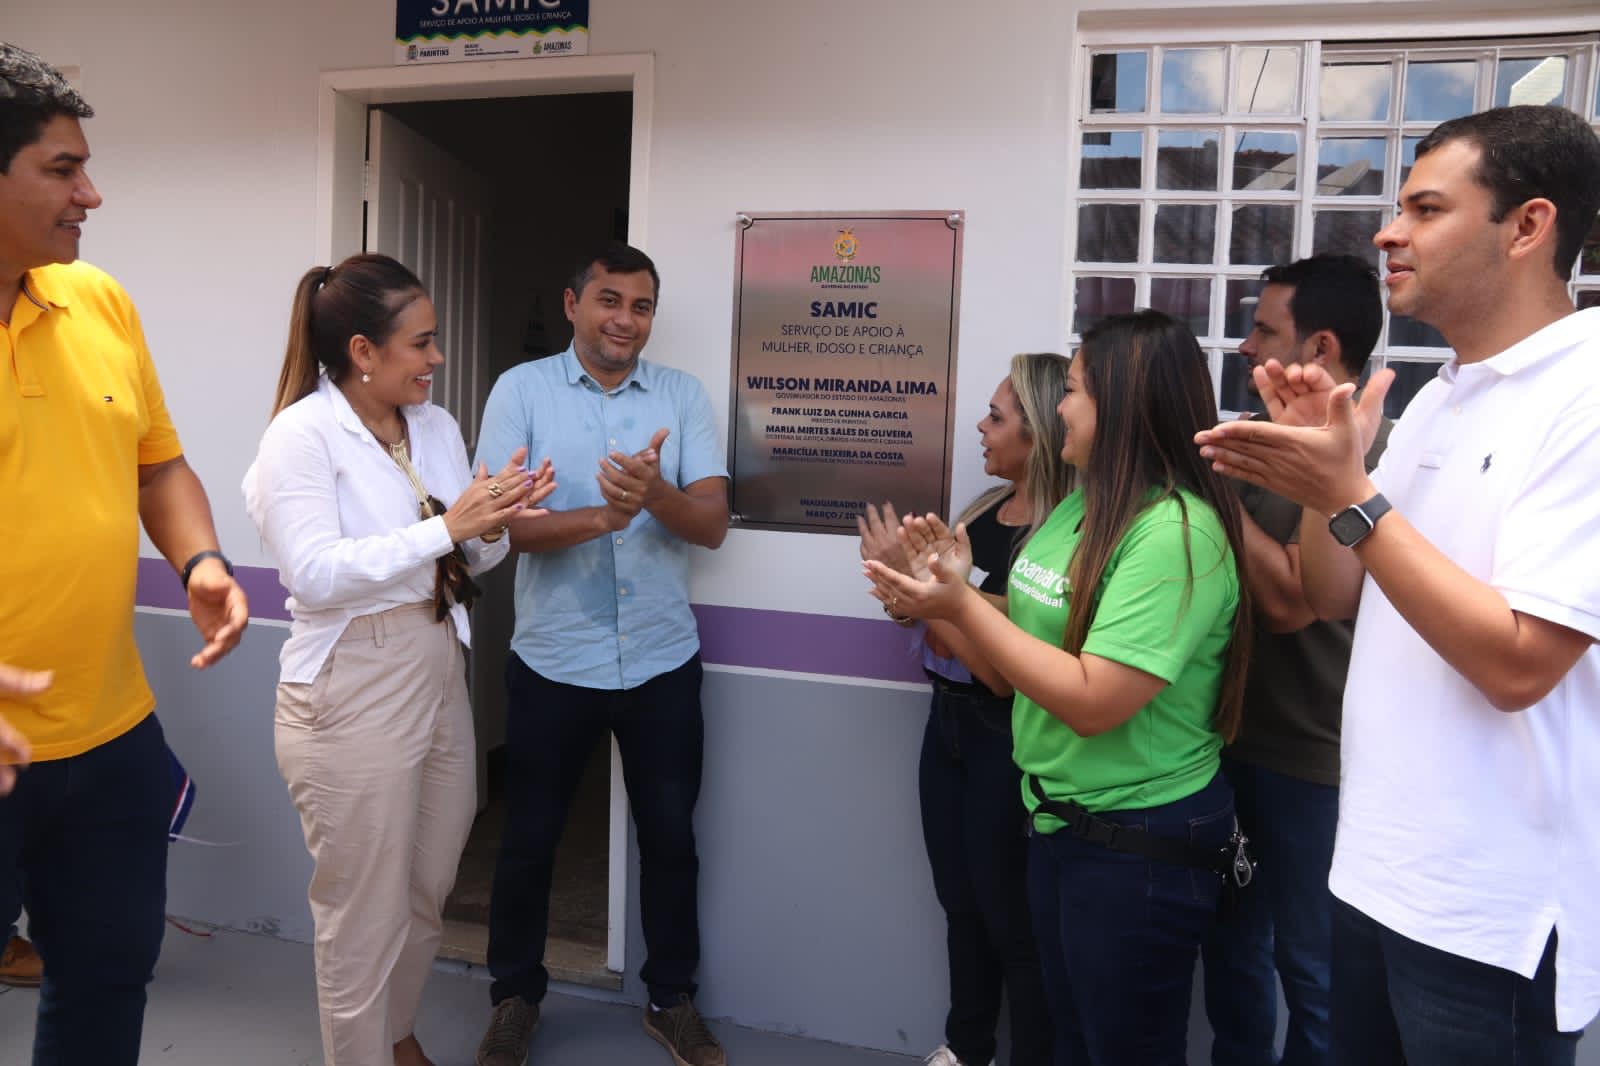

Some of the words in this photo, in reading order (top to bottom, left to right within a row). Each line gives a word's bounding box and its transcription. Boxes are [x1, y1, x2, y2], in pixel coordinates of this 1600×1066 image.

[544, 41, 572, 50] AMAZONAS
[420, 49, 449, 57] PARINTINS
[810, 265, 881, 283] AMAZONAS
[810, 301, 878, 318] SAMIC
[781, 324, 832, 339] SERVIÇO
[835, 325, 849, 337] DE
[853, 325, 893, 338] APOIO
[896, 323, 905, 338] À
[762, 341, 812, 354] MULHER,
[816, 342, 856, 355] IDOSO
[859, 343, 865, 355] E
[868, 343, 924, 359] CRIANÇA
[747, 376, 810, 391] WILSON
[814, 378, 892, 394] MIRANDA
[896, 381, 937, 395] LIMA
[771, 407, 801, 416] FRANK
[802, 408, 822, 417] LUIZ
[824, 409, 836, 417] DA
[838, 409, 871, 418] CUNHA
[872, 410, 908, 420] GARCIA
[766, 425, 795, 434] MARIA
[797, 426, 829, 435] MIRTES
[830, 427, 856, 436] SALES
[858, 428, 869, 436] DE
[870, 429, 913, 438] OLIVEIRA
[820, 448, 857, 458] TEIXEIRA
[859, 450, 872, 459] DA
[874, 451, 904, 460] COSTA
[806, 510, 838, 519] MARÇO
